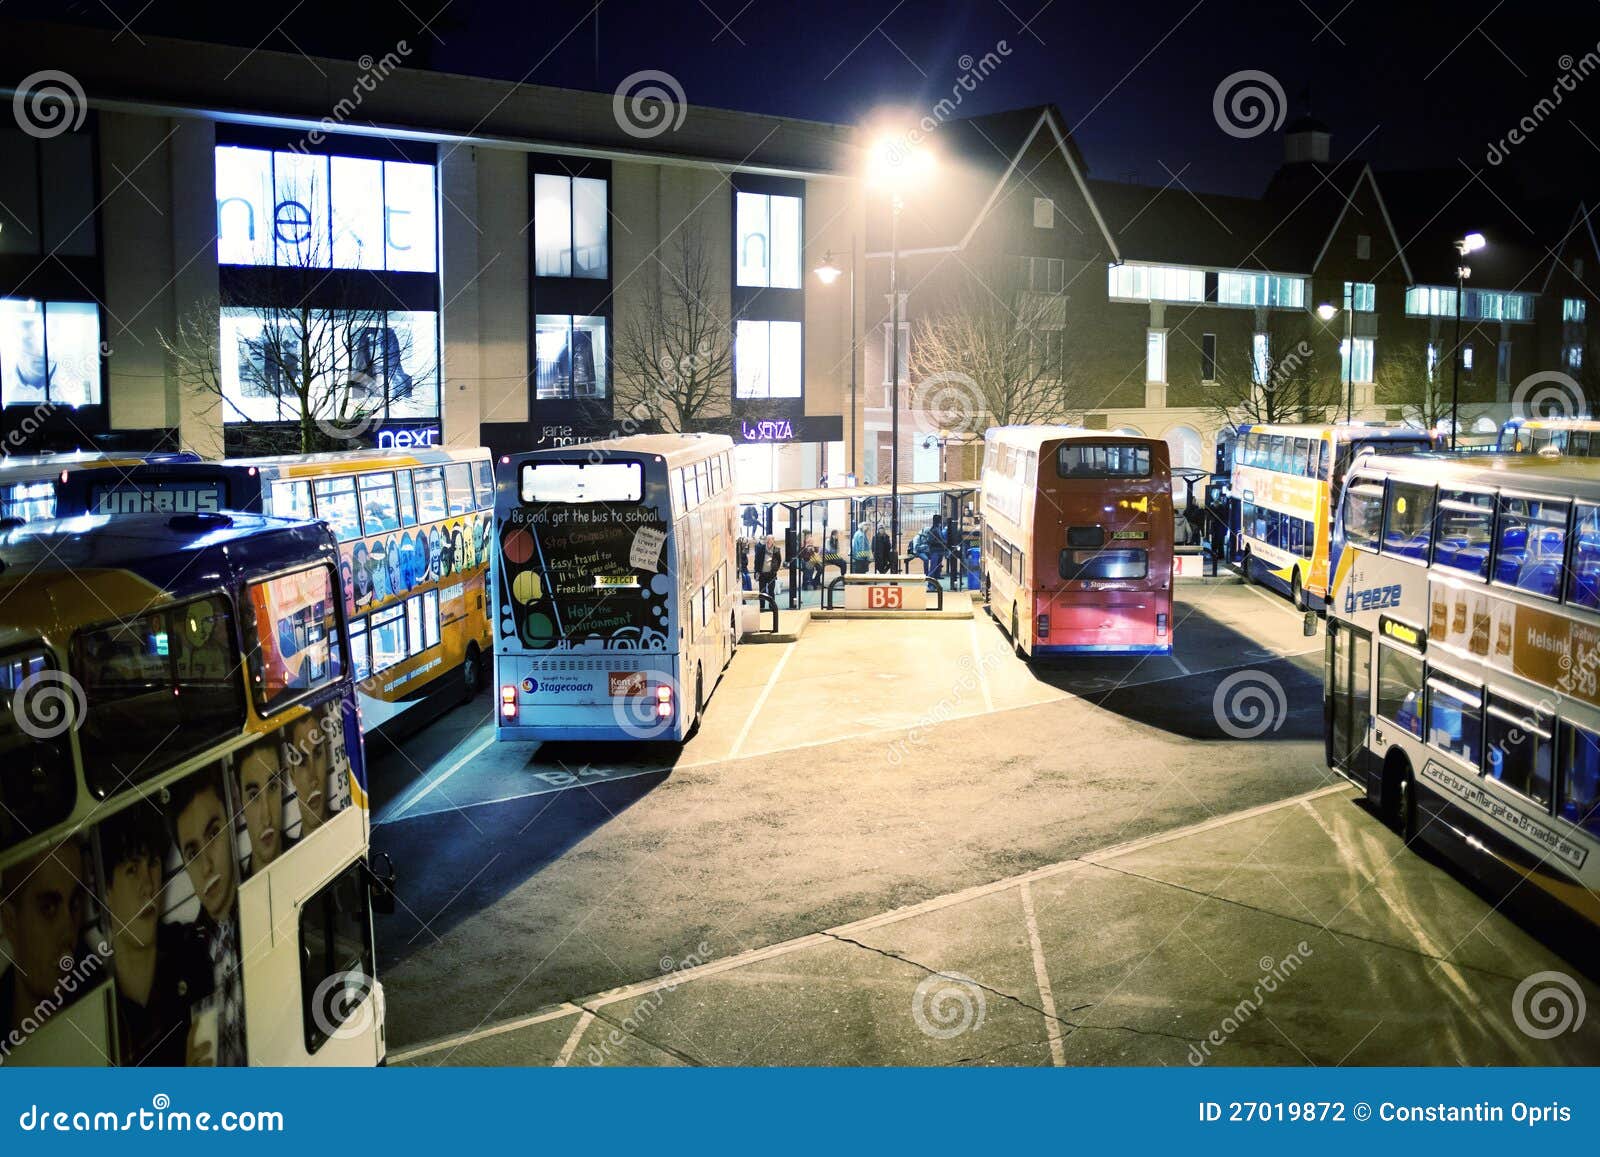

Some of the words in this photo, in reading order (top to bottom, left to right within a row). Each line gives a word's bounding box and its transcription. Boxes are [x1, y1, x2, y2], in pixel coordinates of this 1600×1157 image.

[378, 429, 440, 449] next
[758, 421, 793, 439] SENZA
[512, 509, 524, 523] Be
[527, 510, 549, 524] cool,
[552, 510, 569, 527] get
[573, 509, 588, 523] the
[592, 509, 608, 522] bus
[611, 508, 623, 522] to
[626, 510, 658, 523] school
[551, 558, 573, 571] Easy
[575, 551, 600, 565] travel
[577, 565, 587, 577] 16
[556, 584, 594, 594] Freedom
[872, 587, 900, 608] B5
[1345, 584, 1402, 613] breeze
[567, 604, 593, 618] Help
[565, 611, 633, 634] environment
[539, 682, 593, 694] Stagecoach
[611, 678, 631, 686] Kent
